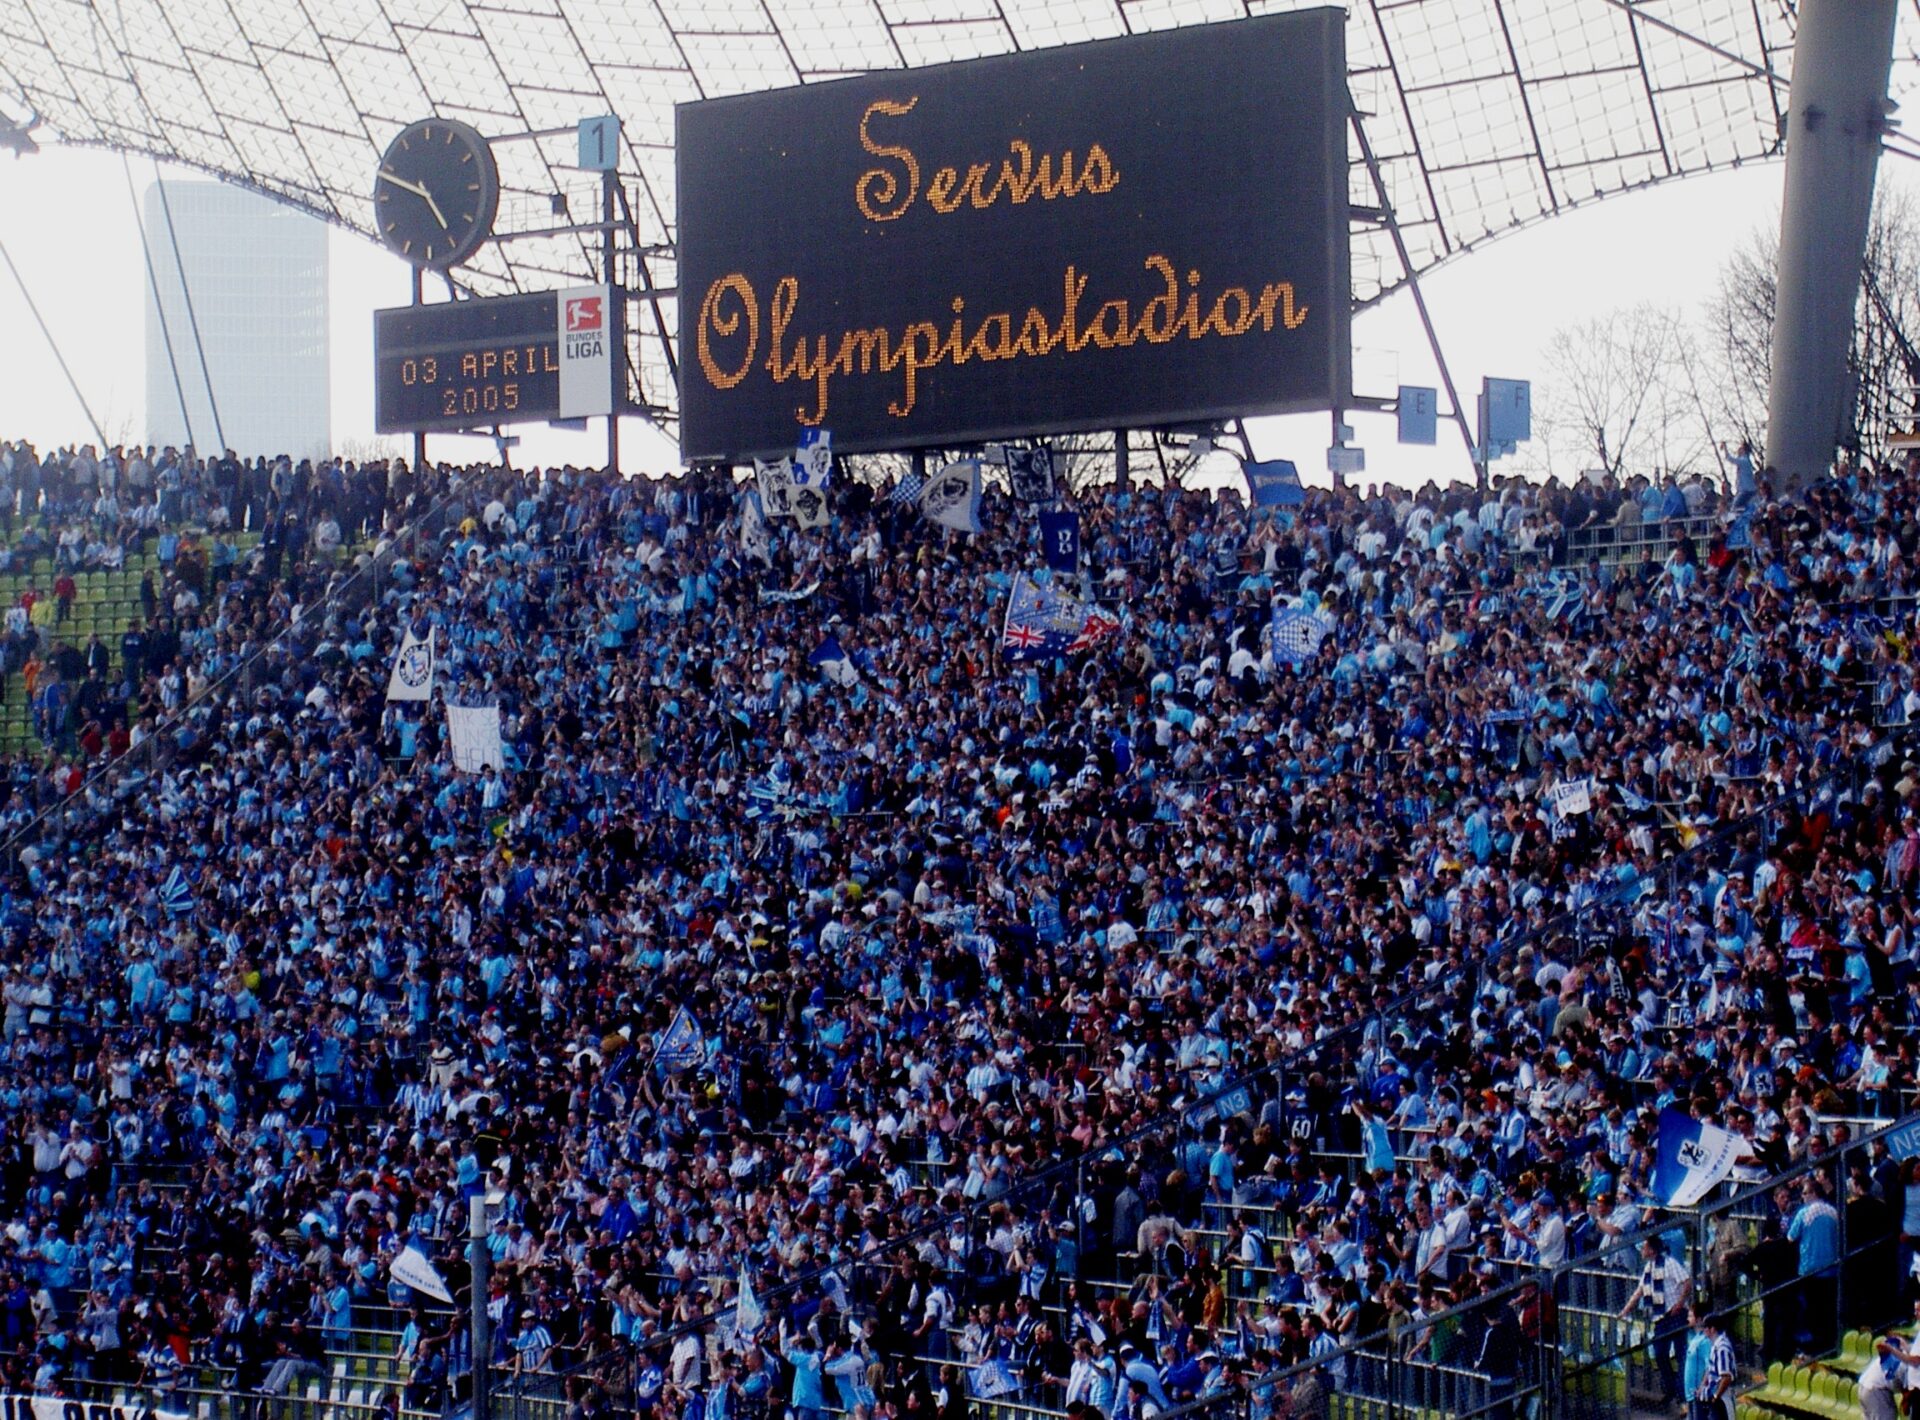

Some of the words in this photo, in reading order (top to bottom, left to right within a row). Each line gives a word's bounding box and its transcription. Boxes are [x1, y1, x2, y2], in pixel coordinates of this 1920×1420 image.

[591, 121, 605, 165] 1
[856, 96, 1120, 222] Servus
[566, 331, 603, 343] BUNDES
[697, 254, 1308, 426] Olympiastadion
[566, 341, 604, 359] LIGA
[442, 383, 520, 416] 2005
[1416, 392, 1426, 415] E
[1514, 386, 1524, 408] F
[1221, 1092, 1246, 1116] N3
[1291, 1119, 1311, 1140] 60
